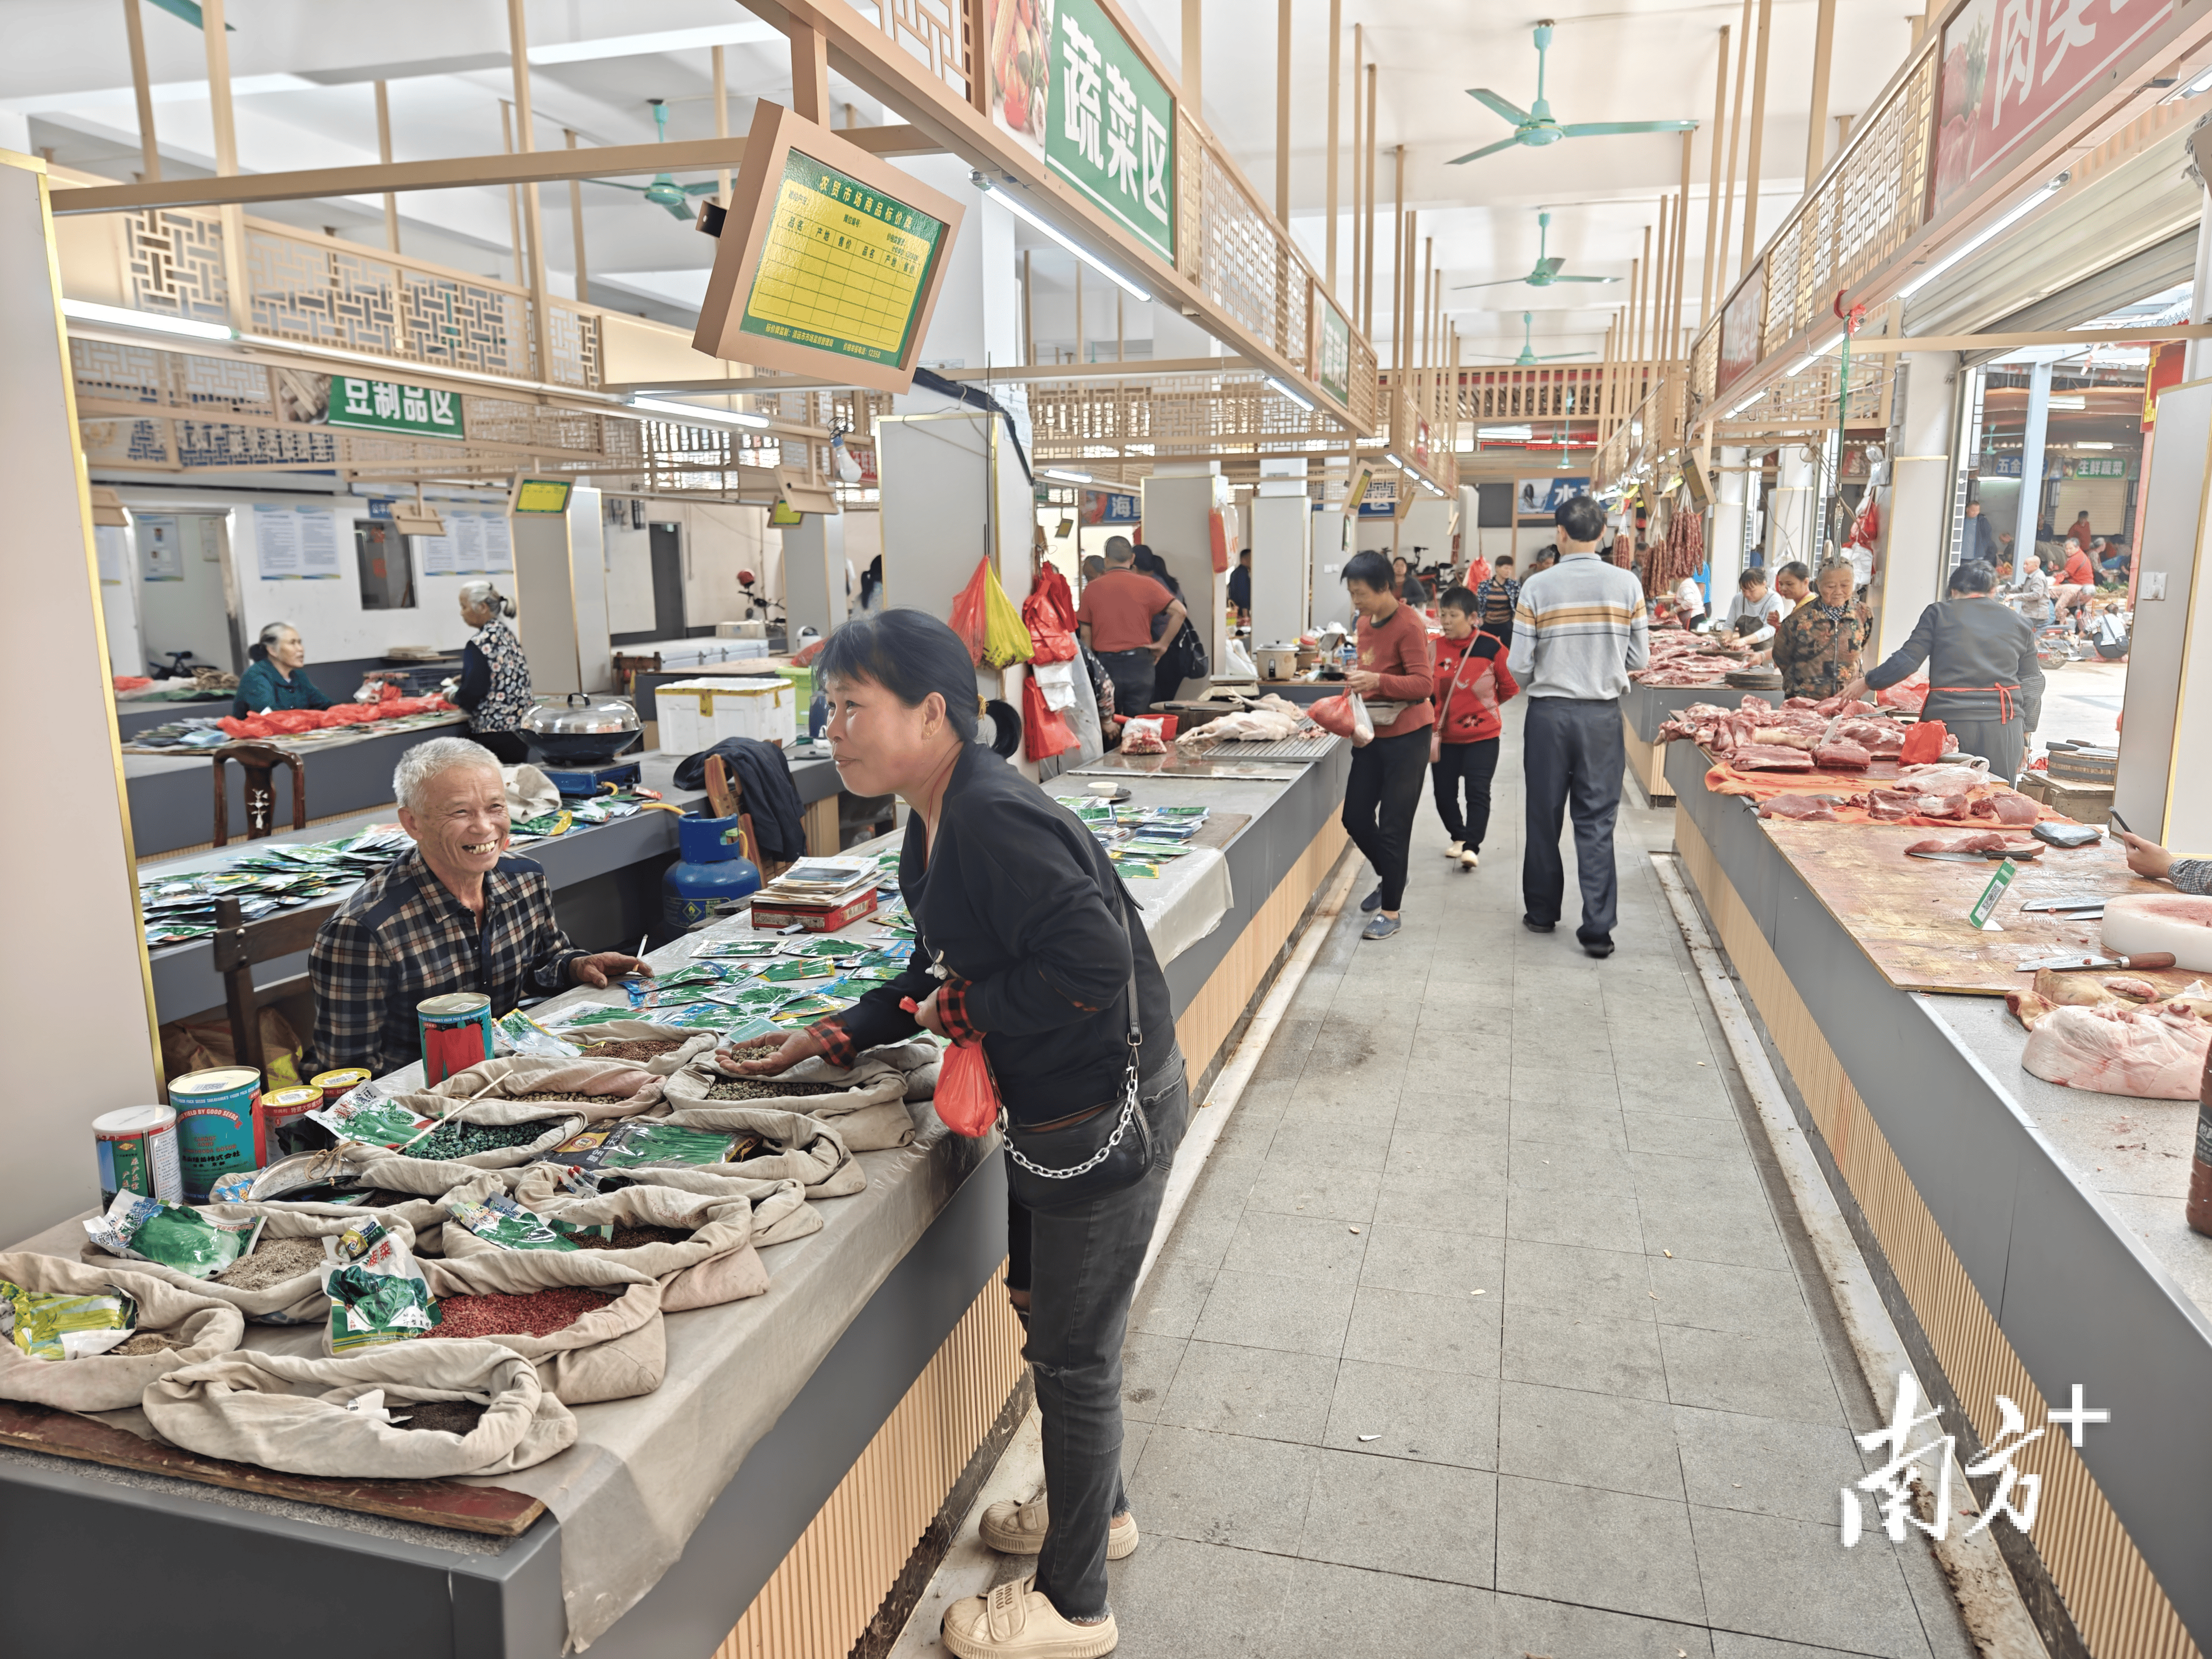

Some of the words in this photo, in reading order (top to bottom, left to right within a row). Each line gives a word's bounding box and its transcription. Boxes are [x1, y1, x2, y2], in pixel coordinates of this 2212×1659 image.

[1062, 12, 1168, 225] 蔬菜区
[815, 227, 831, 241] 产地
[838, 237, 852, 249] 售价
[862, 246, 875, 258] 品名
[344, 377, 455, 426] 豆制品区
[2078, 460, 2123, 476] 生鲜蔬菜
[222, 1110, 239, 1121] SEEDS
